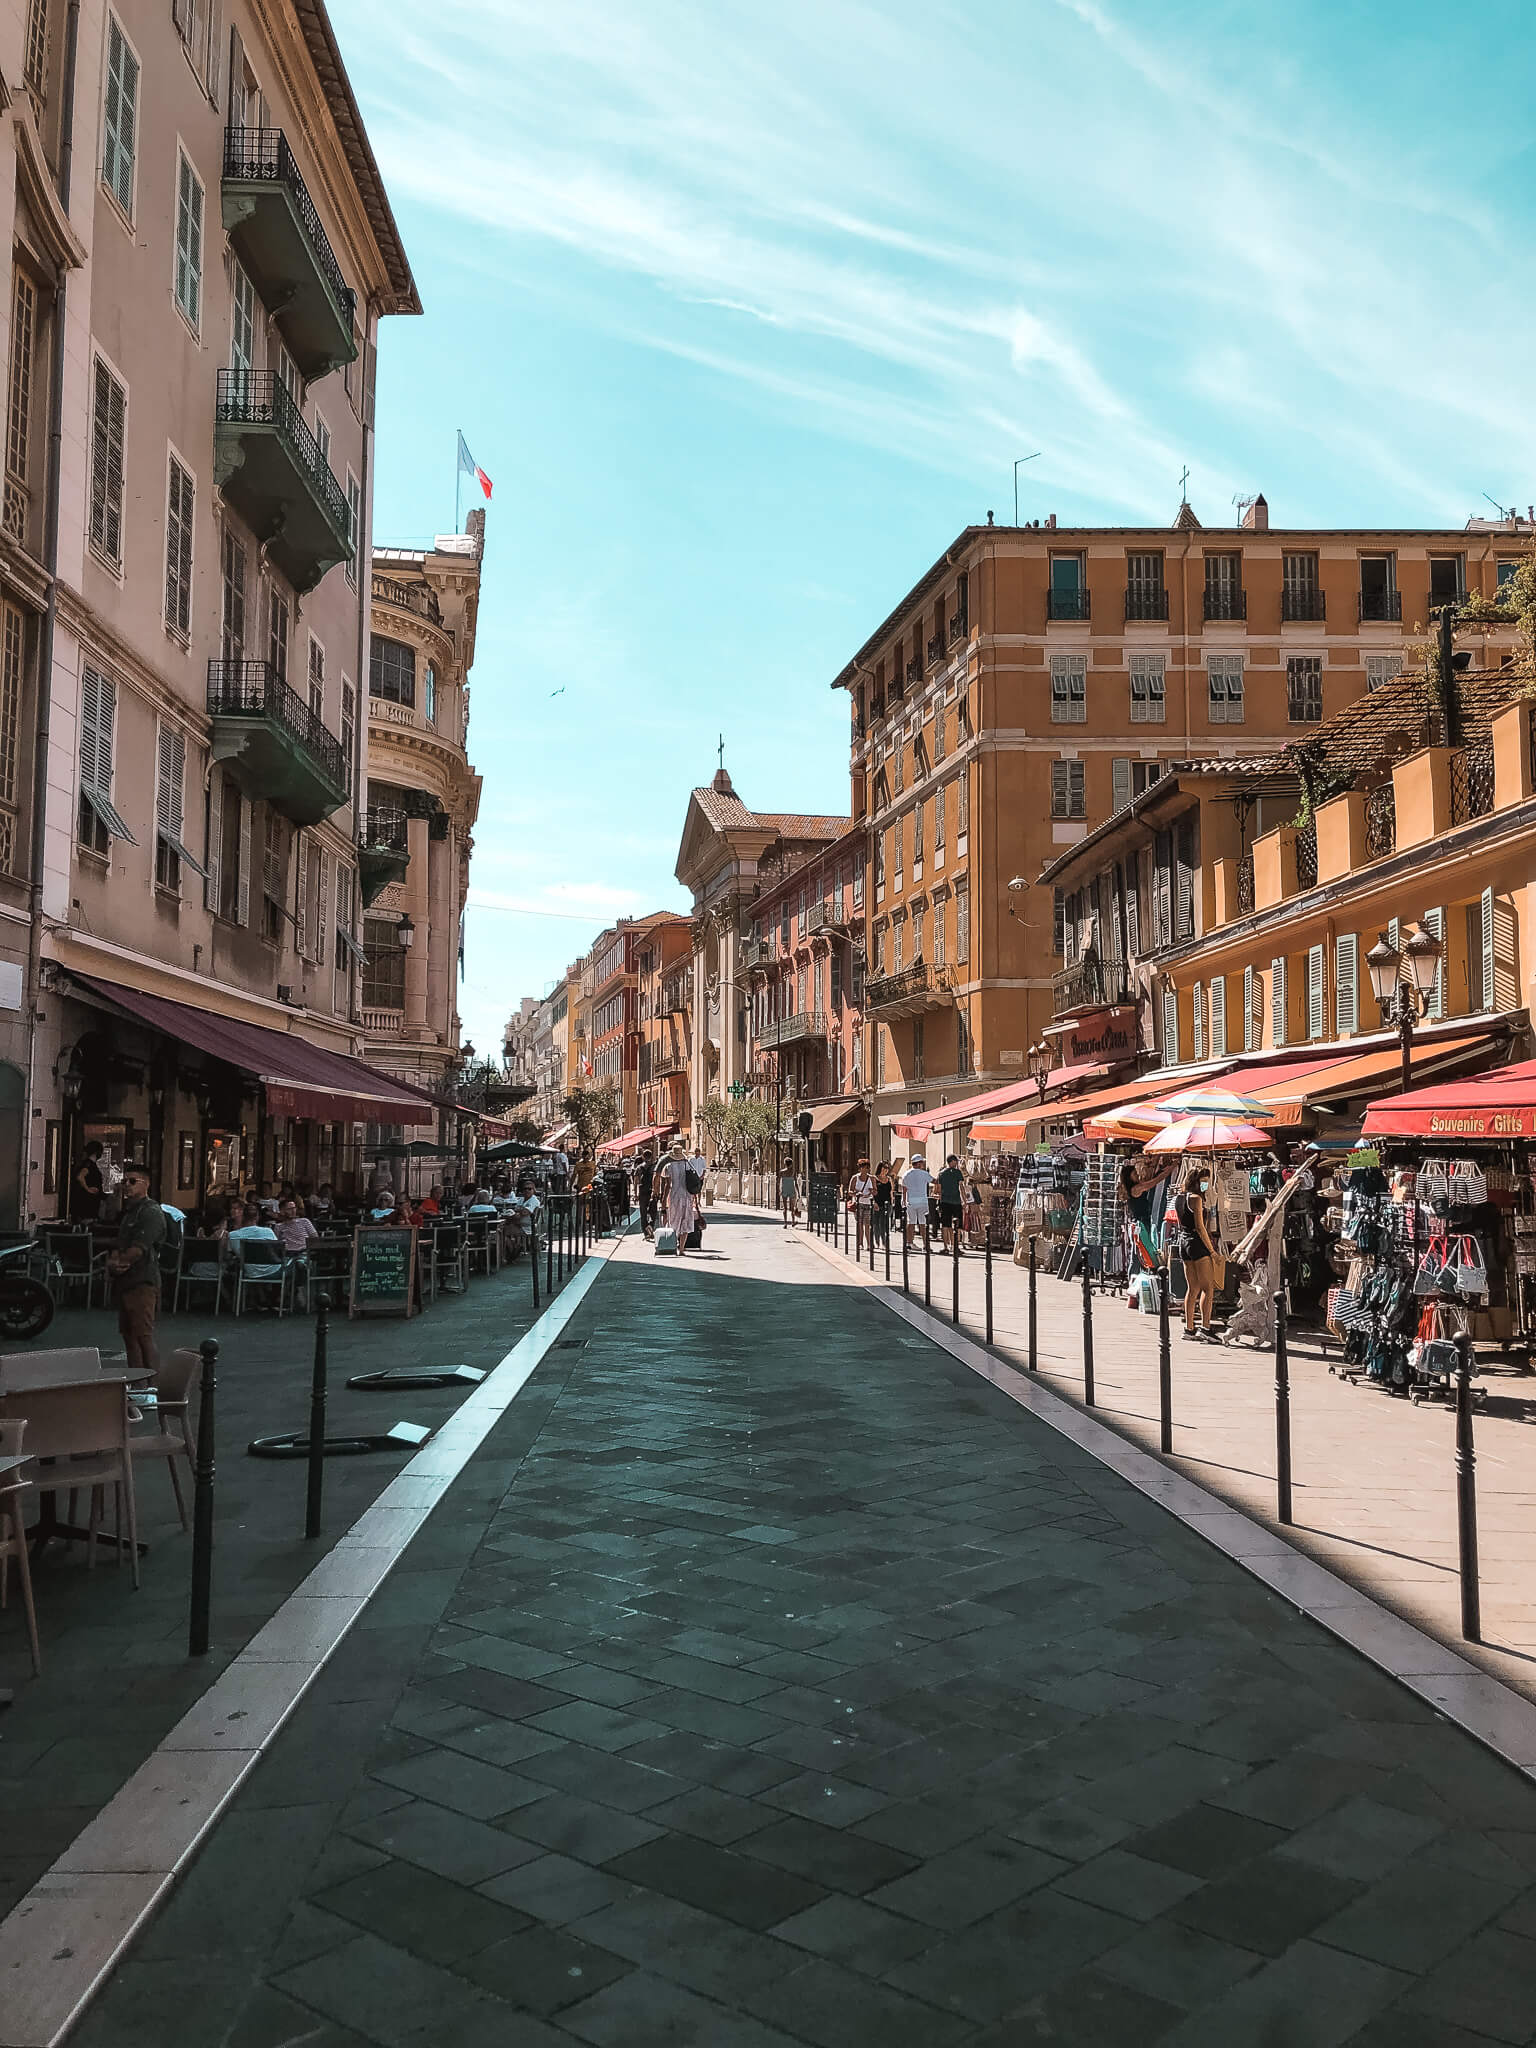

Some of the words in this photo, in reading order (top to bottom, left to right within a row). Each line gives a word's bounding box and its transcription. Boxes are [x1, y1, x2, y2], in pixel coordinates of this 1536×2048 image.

[744, 1074, 772, 1085] AUER
[1431, 1115, 1485, 1132] Souvenirs
[1494, 1114, 1522, 1132] Gifts
